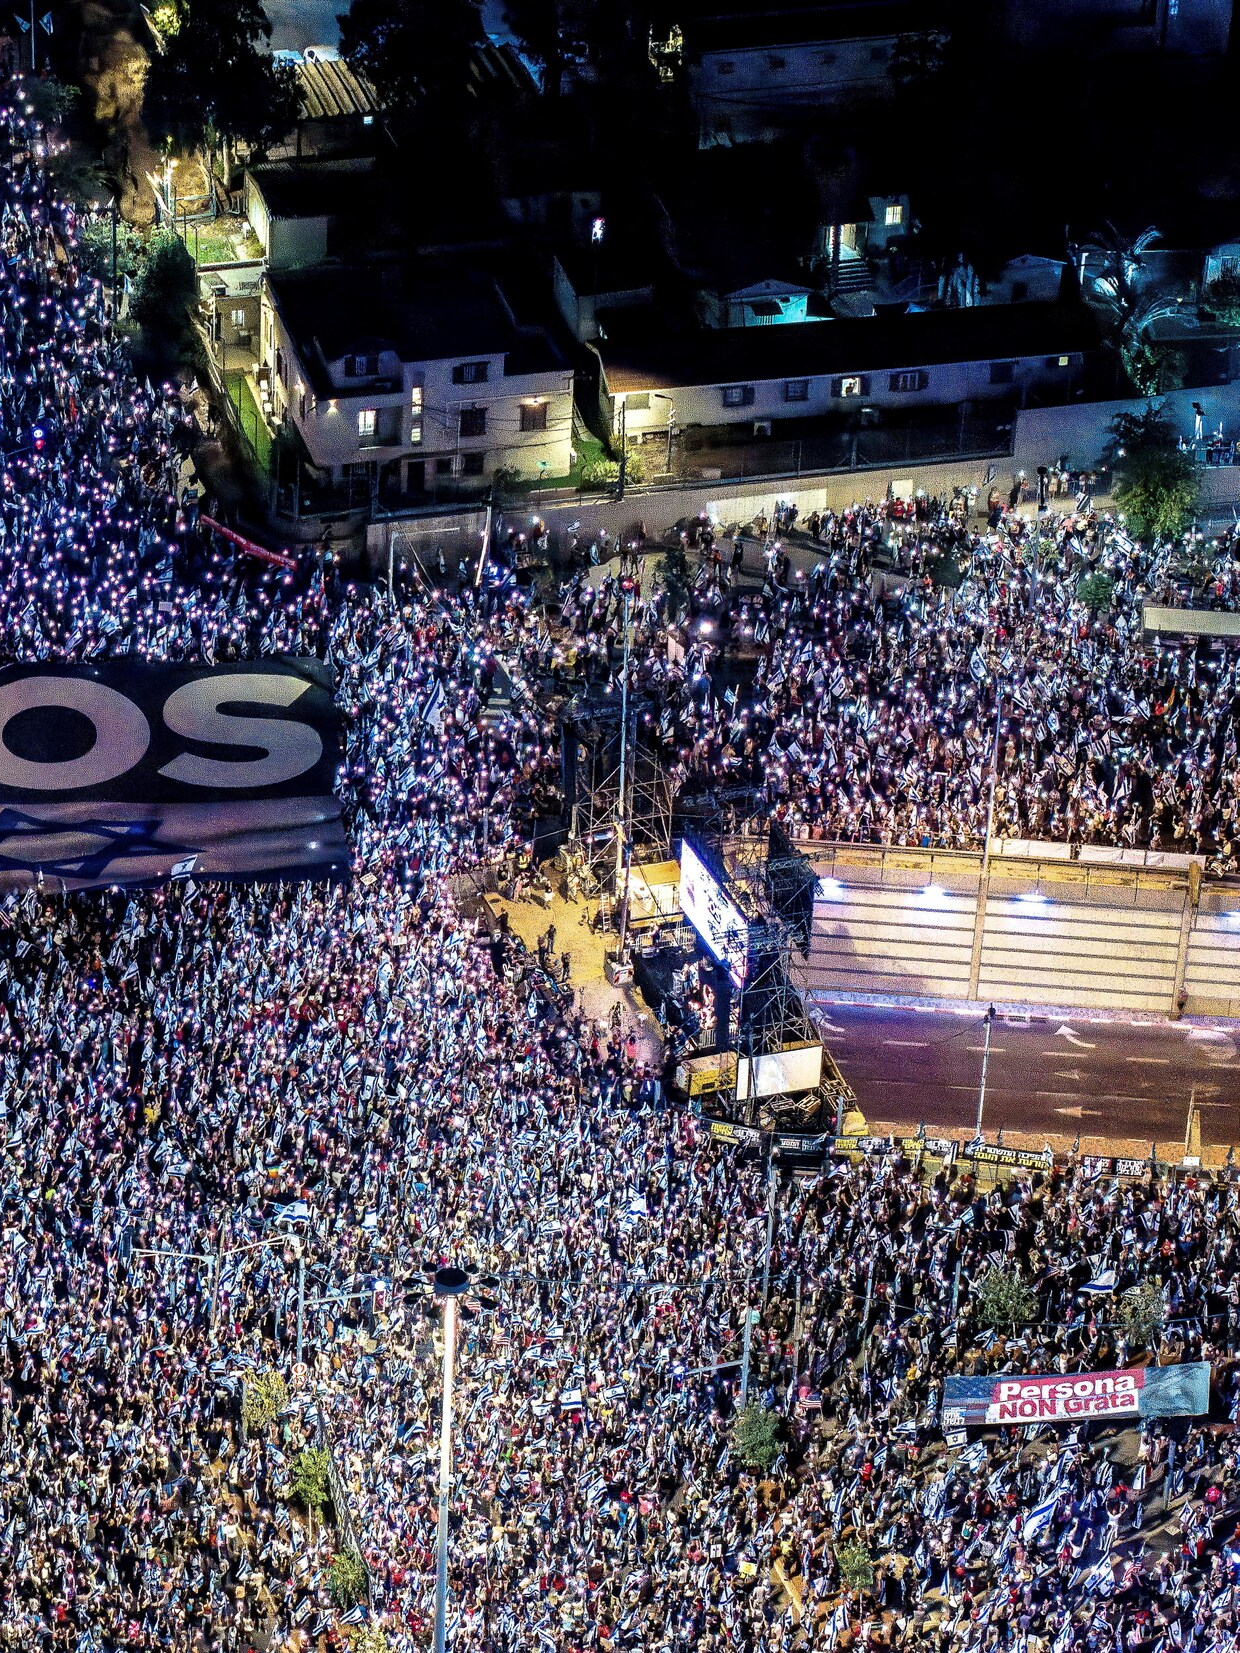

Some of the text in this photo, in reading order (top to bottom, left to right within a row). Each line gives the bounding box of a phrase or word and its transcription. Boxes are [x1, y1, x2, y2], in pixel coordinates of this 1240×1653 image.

[999, 1374, 1135, 1400] Persona
[998, 1390, 1135, 1419] NON Grata
